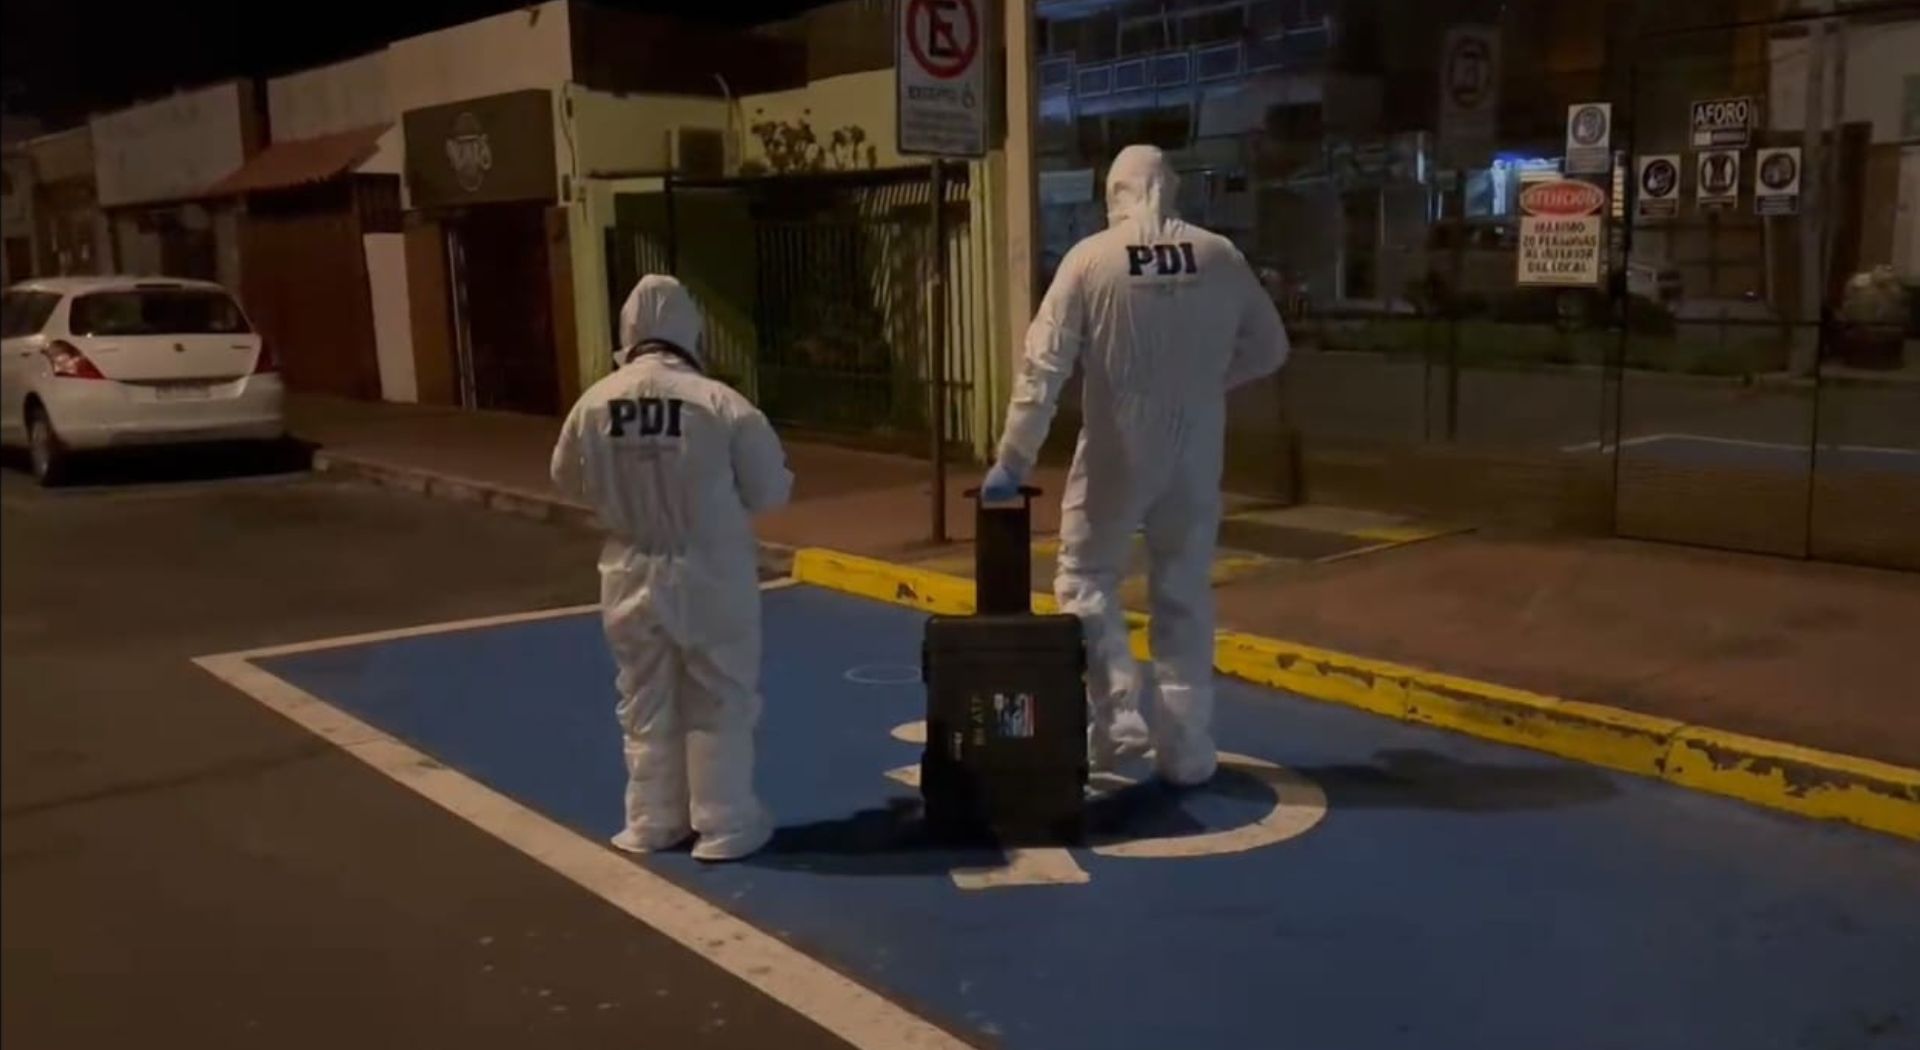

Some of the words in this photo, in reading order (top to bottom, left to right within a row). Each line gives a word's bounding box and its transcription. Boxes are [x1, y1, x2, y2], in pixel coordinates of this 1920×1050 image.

[1695, 101, 1748, 126] AFORO
[1539, 234, 1597, 247] PERSONAS
[1126, 242, 1197, 276] PDI
[1528, 261, 1547, 273] DEL
[1551, 261, 1587, 273] LOCAL
[608, 397, 684, 437] PDI
